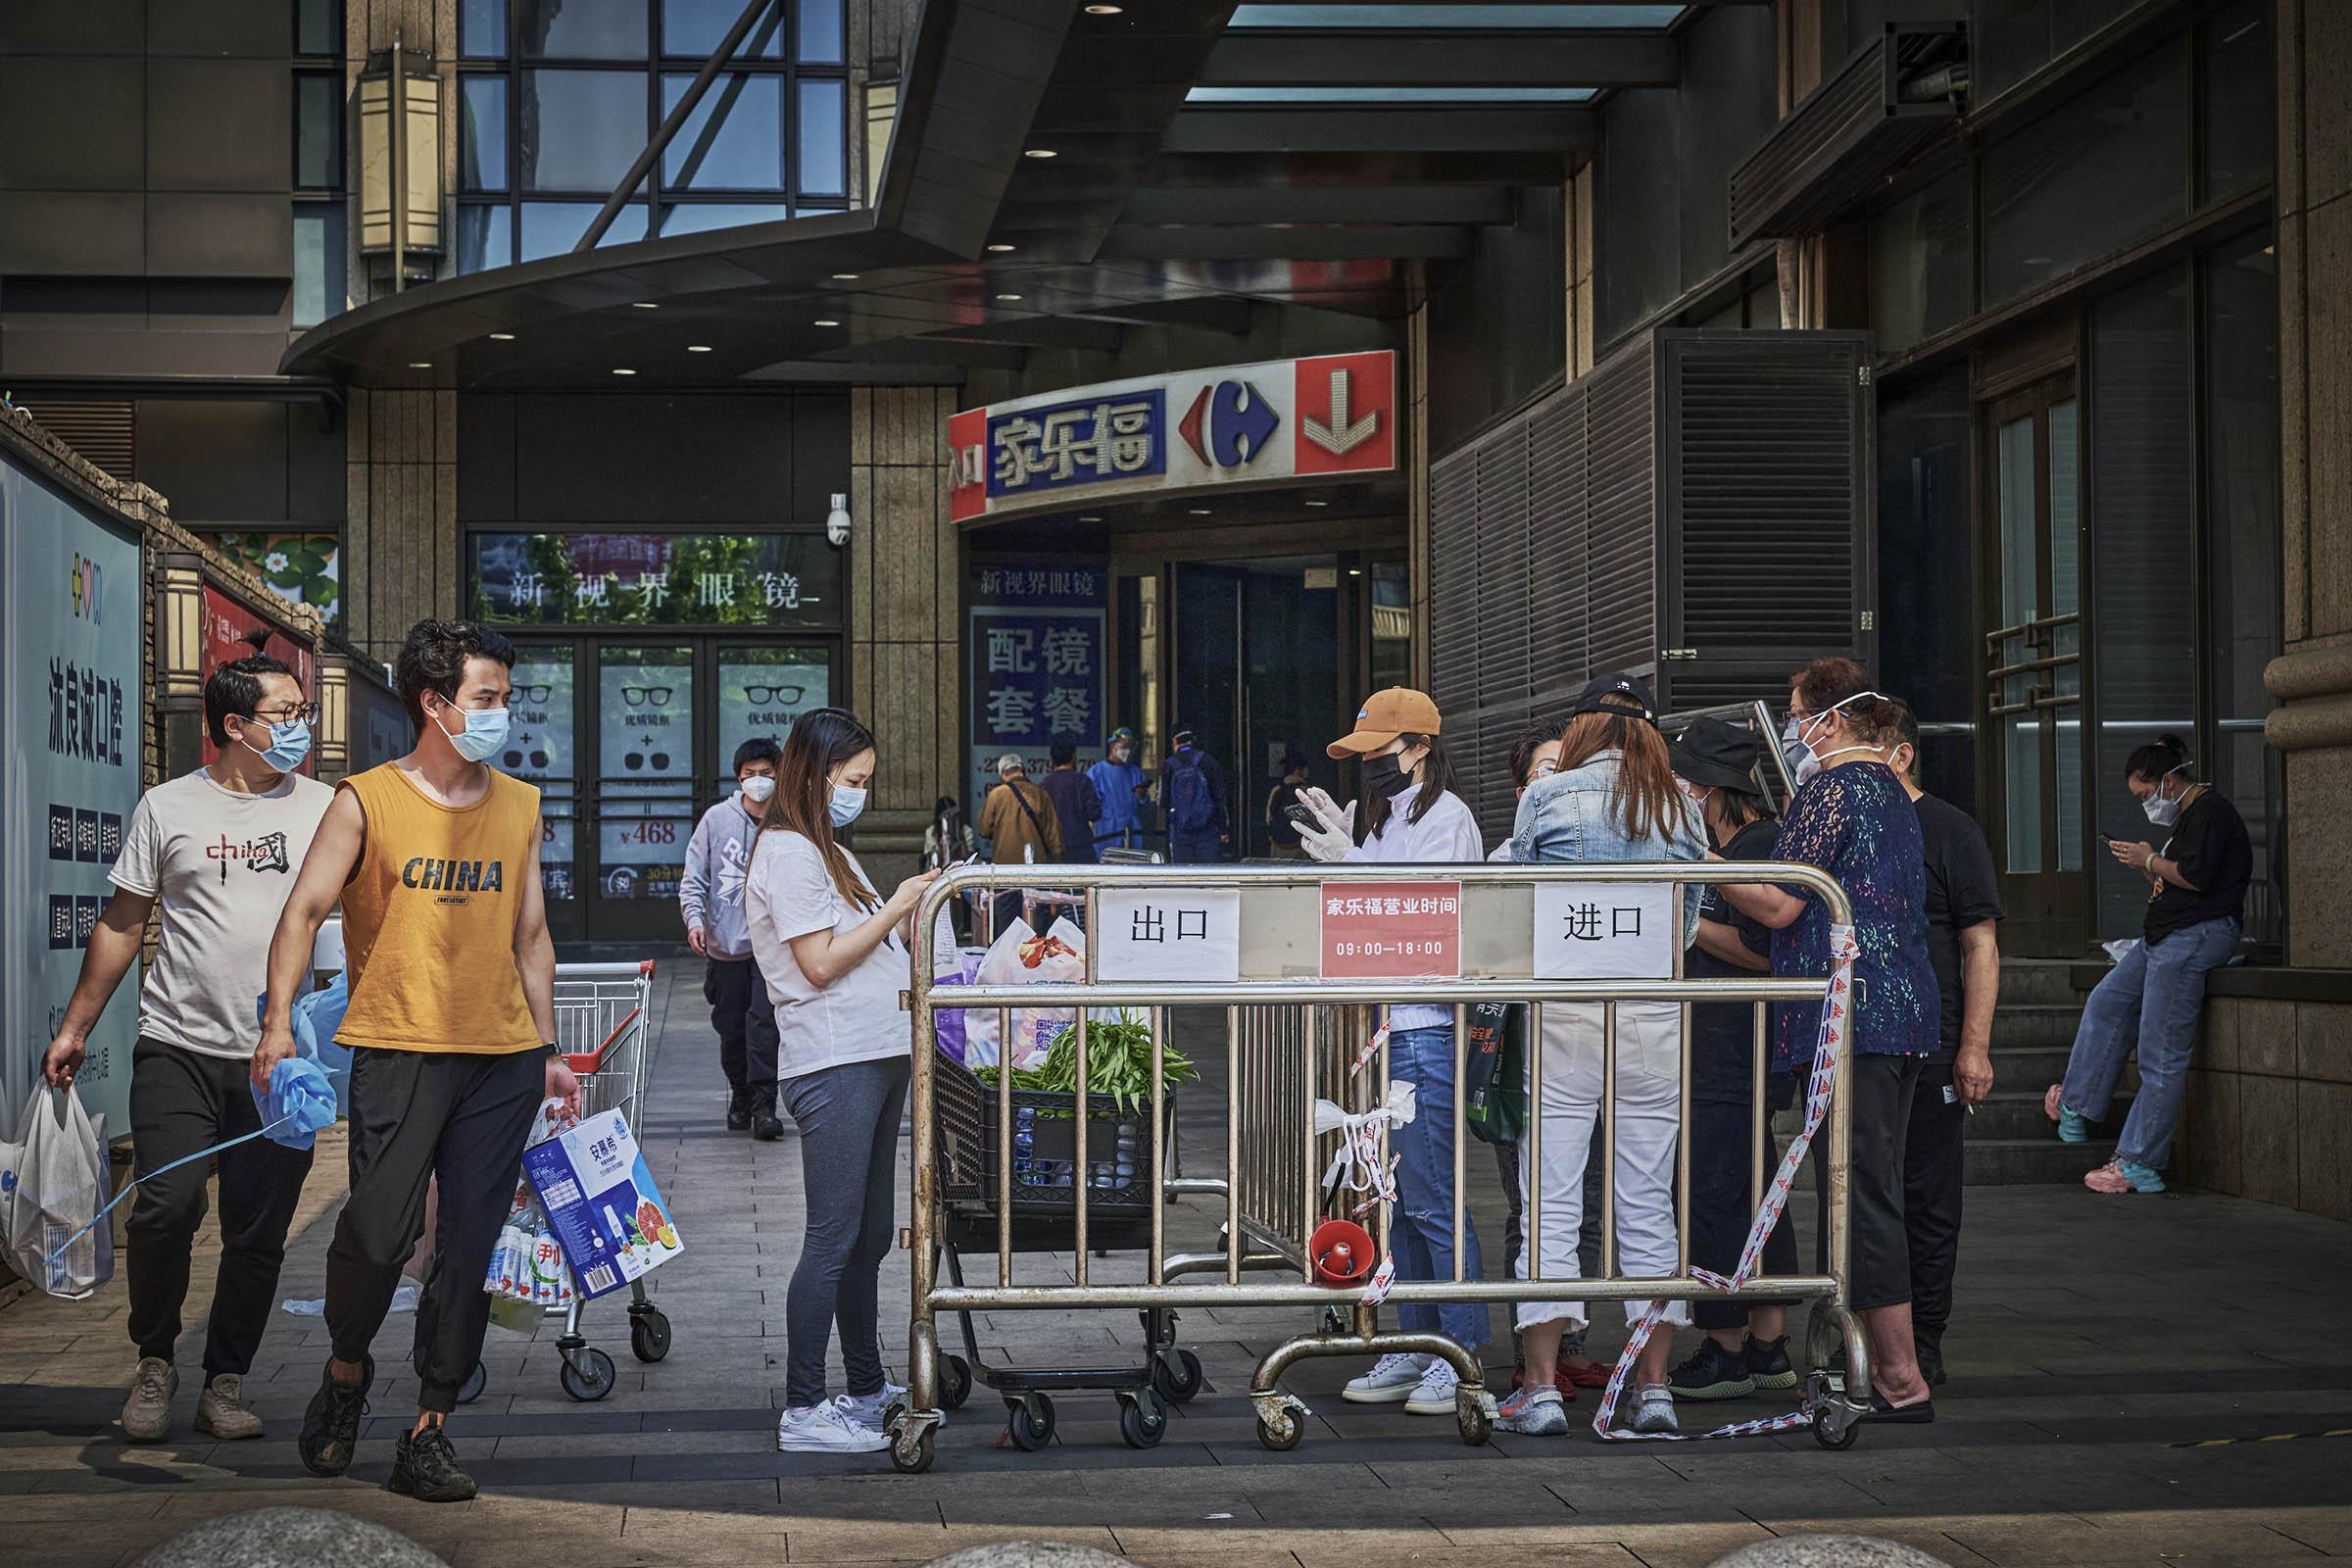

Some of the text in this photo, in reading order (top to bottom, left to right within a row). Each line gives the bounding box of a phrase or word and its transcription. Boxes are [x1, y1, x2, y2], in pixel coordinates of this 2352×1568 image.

[995, 402, 1153, 488] 家乐福
[510, 571, 800, 610] 新视界眼镜
[980, 570, 1096, 596] 新视界眼镜
[987, 627, 1091, 676] 配镜
[987, 688, 1091, 736] 套餐
[402, 858, 503, 892] CHINA
[1132, 906, 1207, 943] 出口
[1326, 897, 1457, 915] 家乐福营业时间
[1563, 903, 1642, 941] 进口
